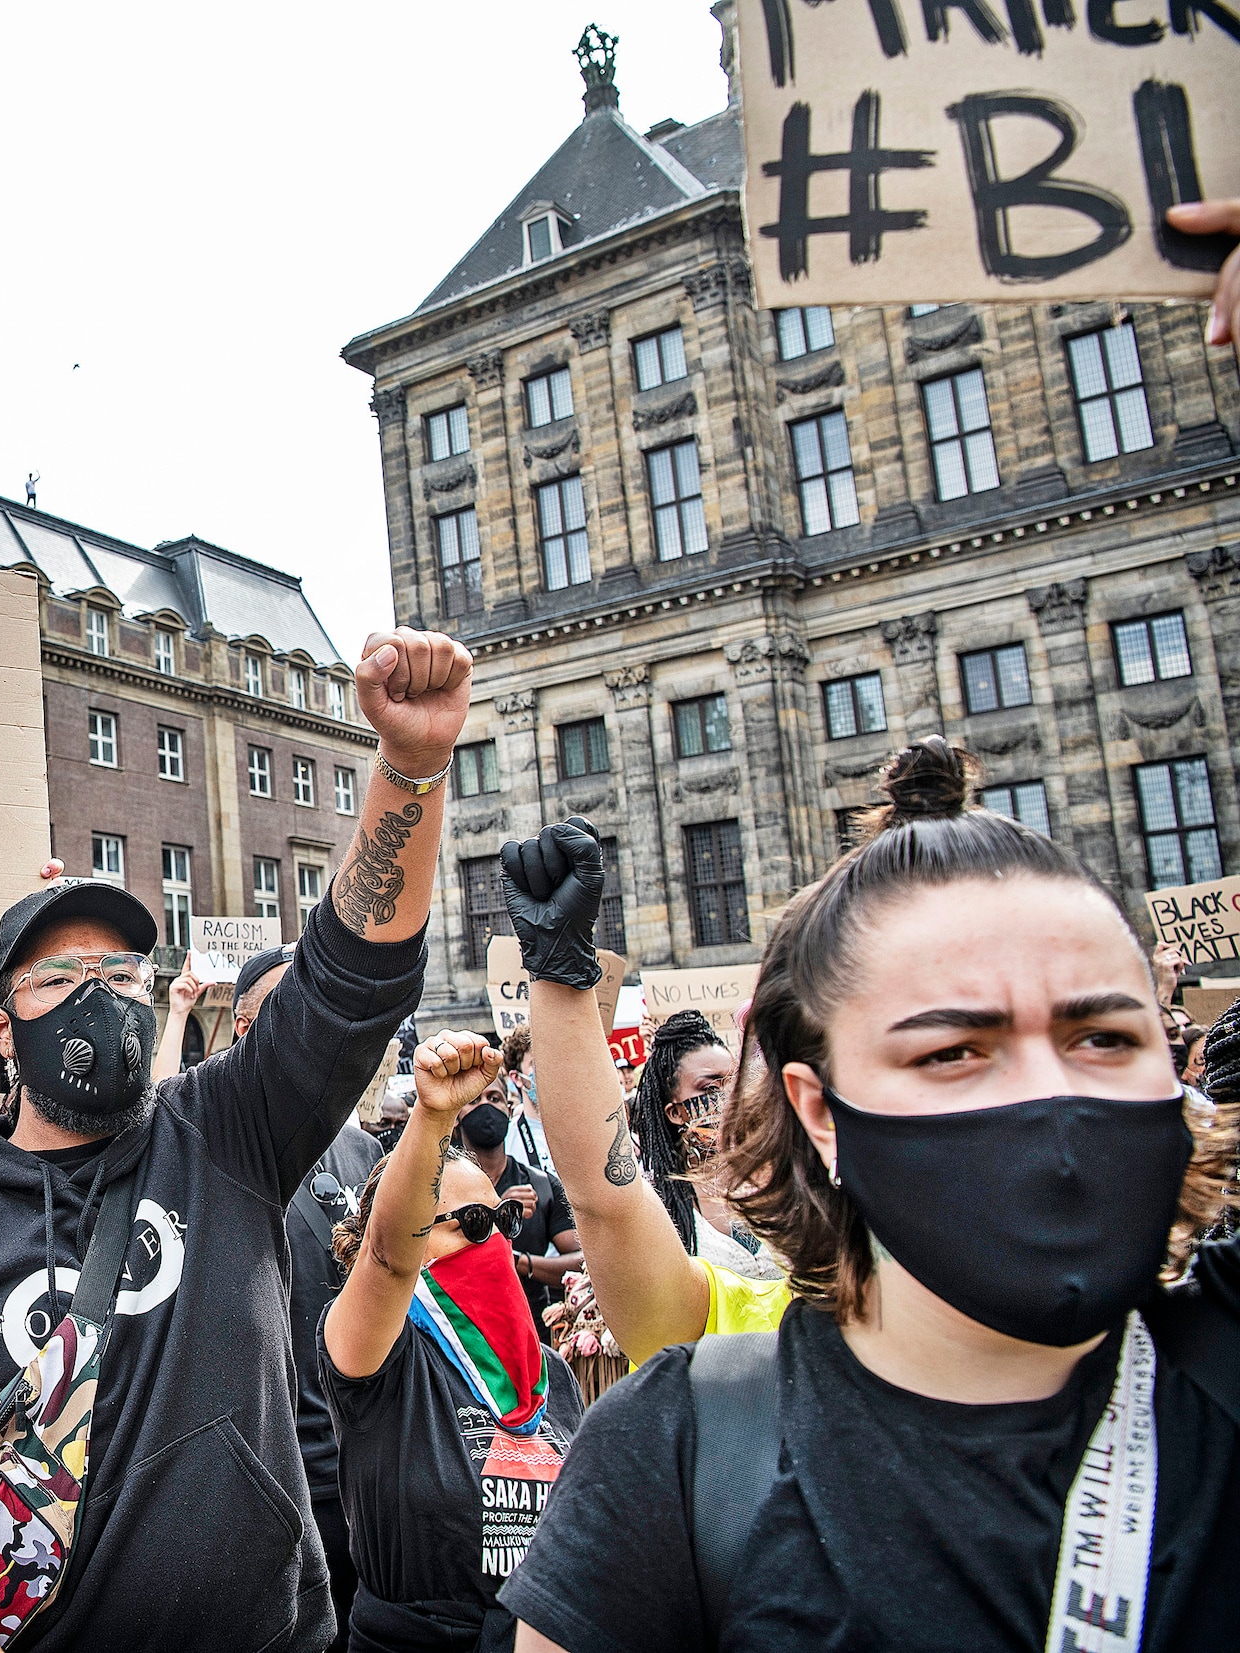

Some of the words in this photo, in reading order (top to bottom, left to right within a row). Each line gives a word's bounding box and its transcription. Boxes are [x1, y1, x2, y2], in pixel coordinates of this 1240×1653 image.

[1152, 891, 1228, 926] BLACK
[1160, 918, 1224, 943] LIVES
[207, 941, 218, 950] IS
[222, 941, 239, 951] THE
[243, 942, 264, 951] REAL
[652, 985, 681, 1006] NO
[688, 982, 740, 1001] LIVES
[482, 1478, 531, 1510] SAKA
[518, 1512, 534, 1524] THE
